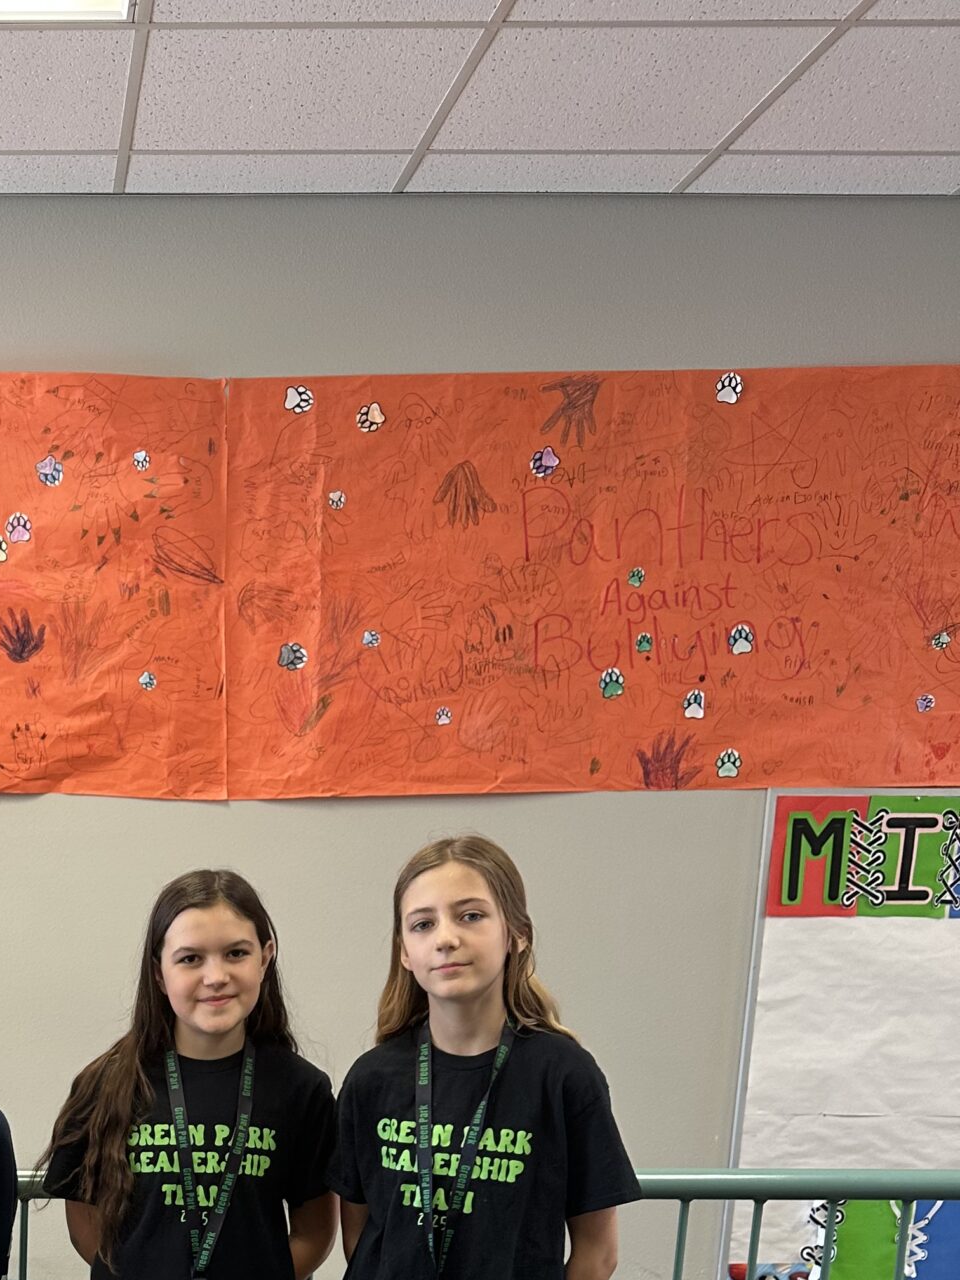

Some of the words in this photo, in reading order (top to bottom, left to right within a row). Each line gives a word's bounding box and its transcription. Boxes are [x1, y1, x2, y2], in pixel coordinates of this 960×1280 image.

[521, 485, 813, 568] Panthers
[600, 572, 738, 624] Against
[533, 613, 805, 681] Bullying
[418, 1042, 429, 1061] Park
[244, 1057, 254, 1075] Park
[418, 1062, 429, 1085] Green
[169, 1073, 180, 1090] Park
[242, 1075, 253, 1097] Green
[174, 1106, 185, 1130] Green
[238, 1113, 249, 1130] Park
[418, 1104, 429, 1123] Park
[177, 1130, 188, 1149] Park
[232, 1130, 246, 1154] Green
[376, 1118, 454, 1148] GREN
[460, 1125, 533, 1155] ARK
[418, 1124, 429, 1149] Green
[466, 1125, 480, 1145] Park
[381, 1146, 525, 1183] LEAESHIP
[221, 1172, 235, 1190] Park
[421, 1167, 431, 1188] Park
[456, 1164, 471, 1189] Green
[214, 1190, 229, 1215] Green
[417, 1212, 448, 1231] 225
[202, 1231, 217, 1249] Park
